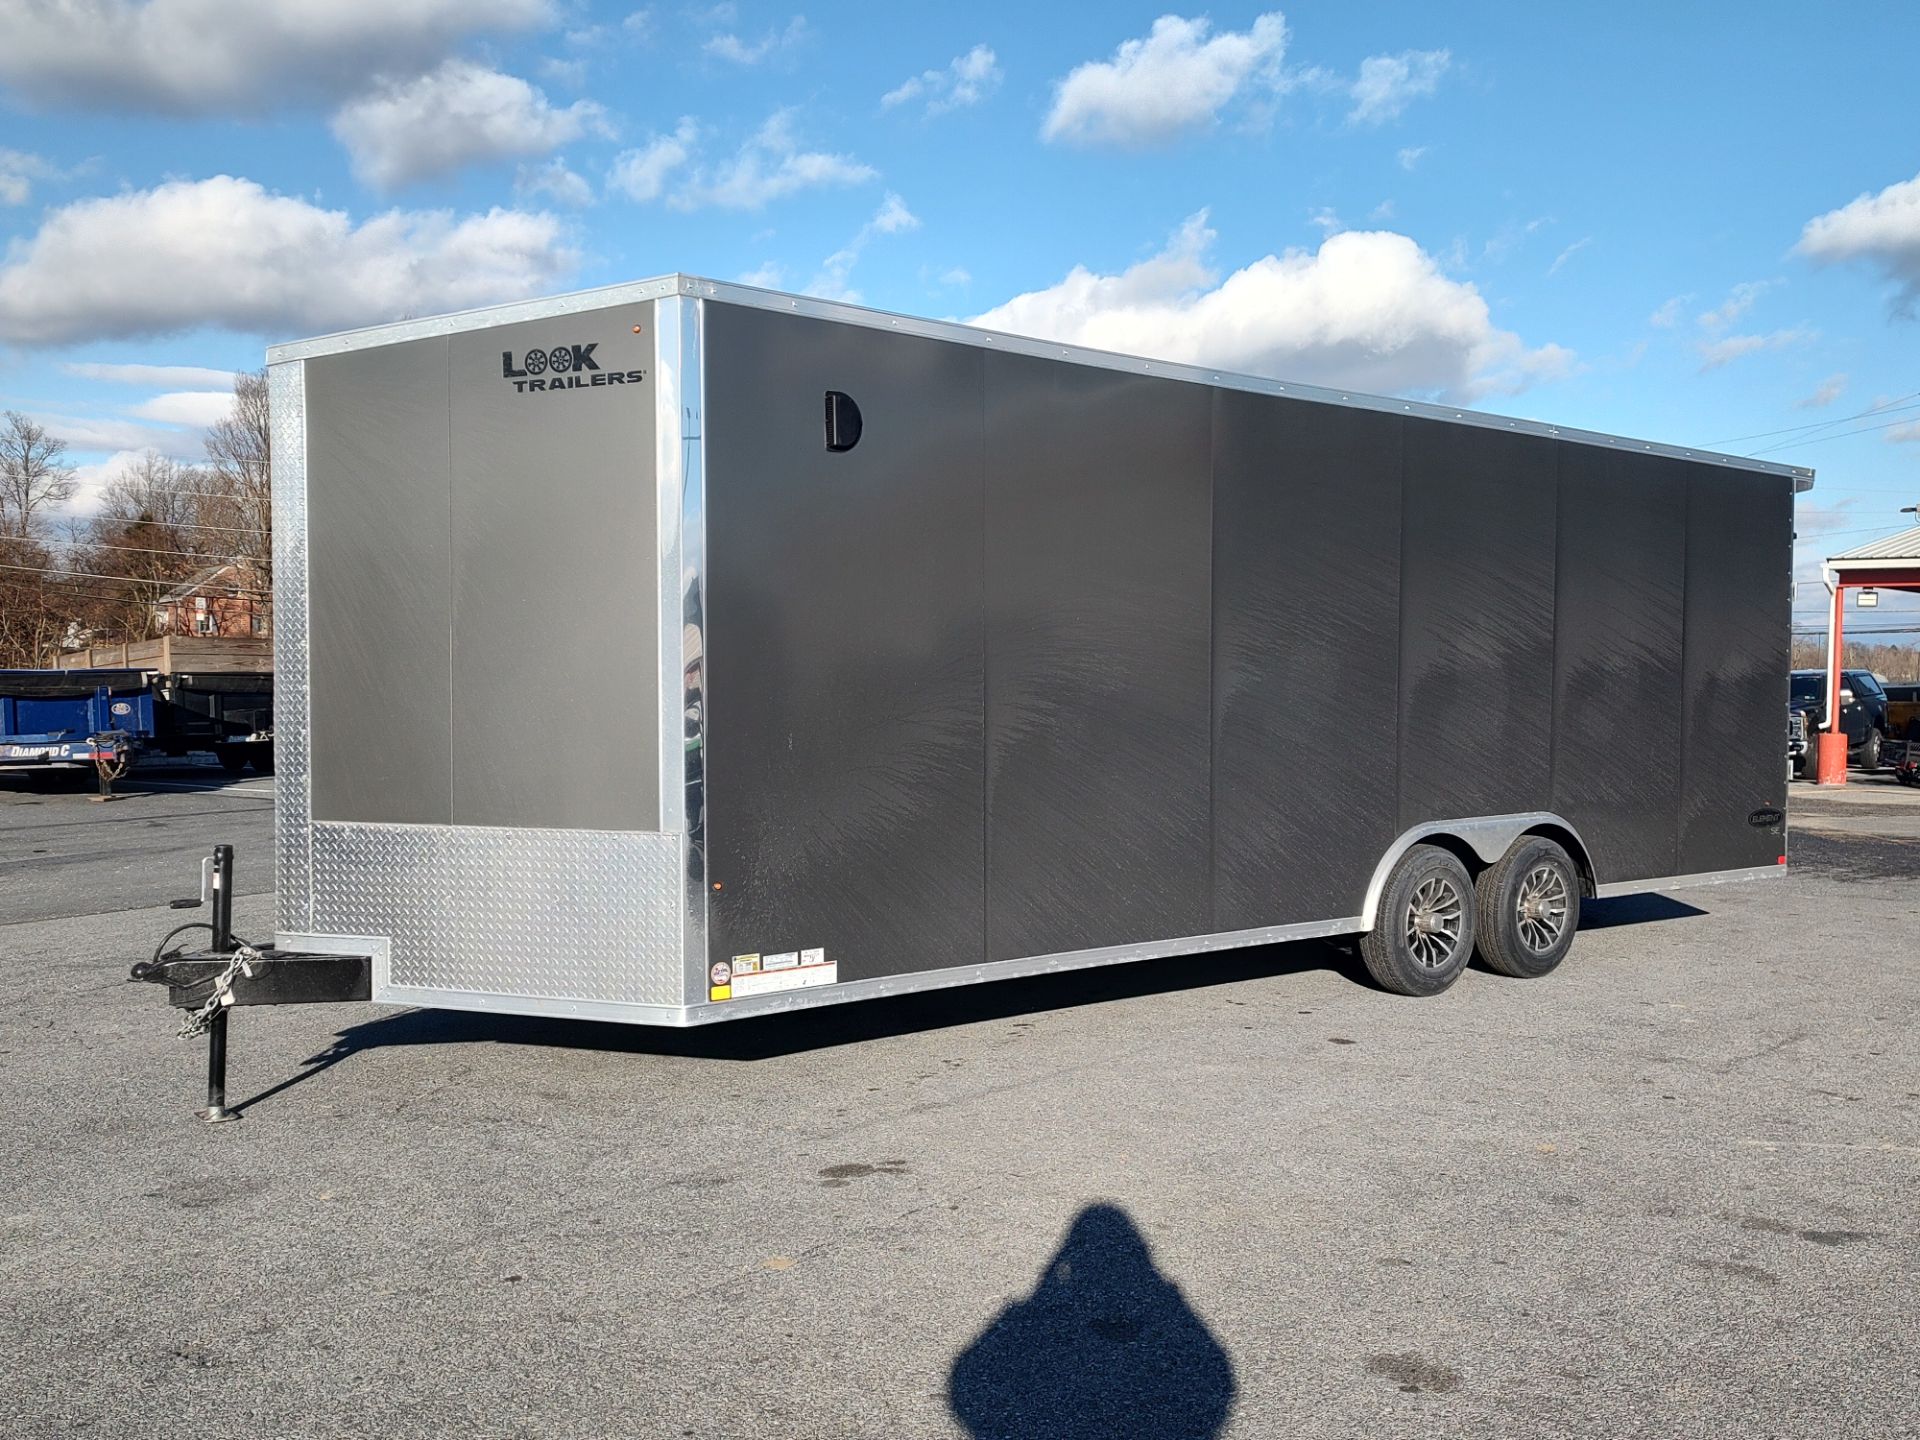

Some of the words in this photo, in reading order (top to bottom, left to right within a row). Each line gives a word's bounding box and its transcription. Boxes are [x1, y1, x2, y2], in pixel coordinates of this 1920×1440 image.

[502, 343, 600, 378] LOOK
[512, 370, 643, 393] TRAILERS
[60, 744, 70, 757] C
